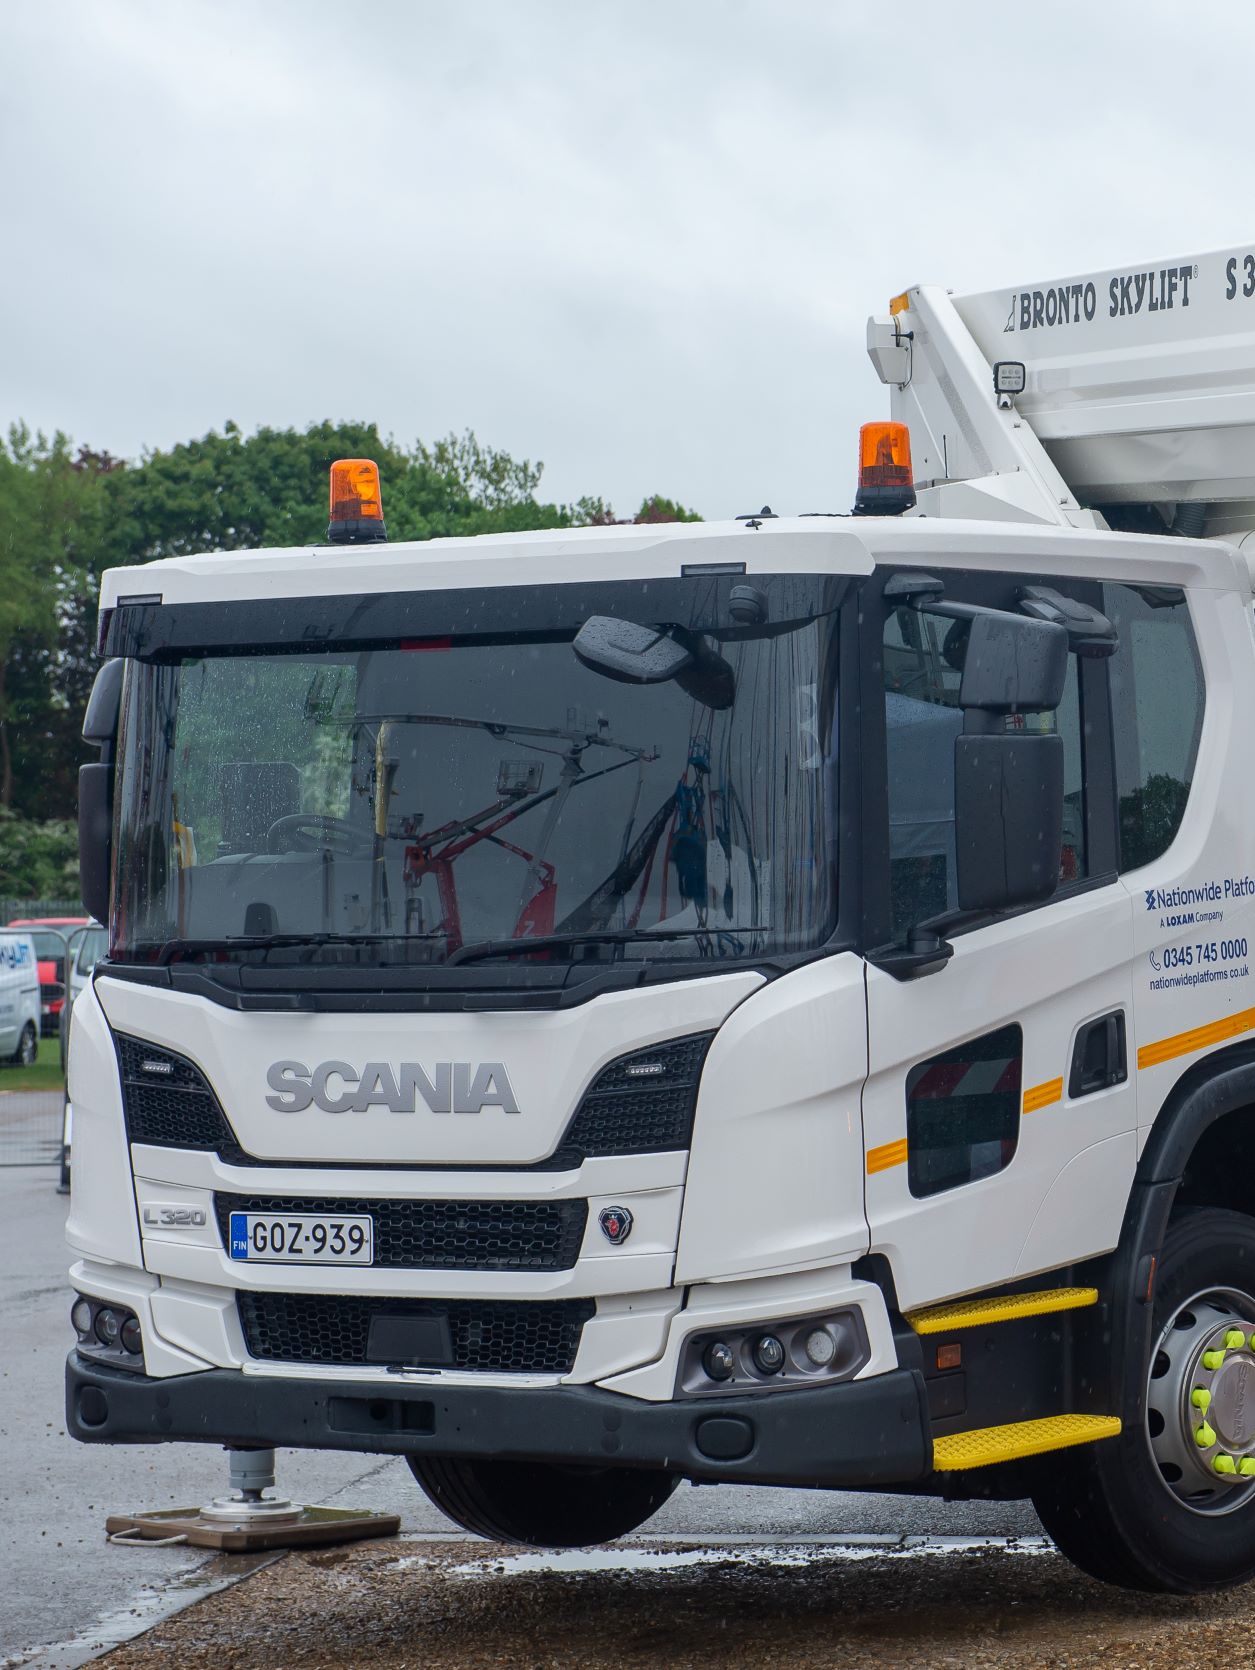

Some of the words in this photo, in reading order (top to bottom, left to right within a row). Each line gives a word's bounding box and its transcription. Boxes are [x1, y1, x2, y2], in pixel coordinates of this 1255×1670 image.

[1225, 257, 1237, 301] S
[1019, 281, 1096, 331] BRONTO
[1156, 881, 1222, 909] Nationwide
[1160, 919, 1165, 928] A
[1166, 913, 1195, 927] LOXAM
[1195, 910, 1224, 923] Company
[1163, 945, 1193, 969] 0345
[1196, 942, 1218, 963] 745
[1221, 938, 1248, 960] 0000
[265, 1060, 522, 1114] SCANIA
[143, 1208, 158, 1225] L
[161, 1208, 207, 1226] 320
[233, 1240, 247, 1251] FIN
[252, 1221, 365, 1256] GOZ-939
